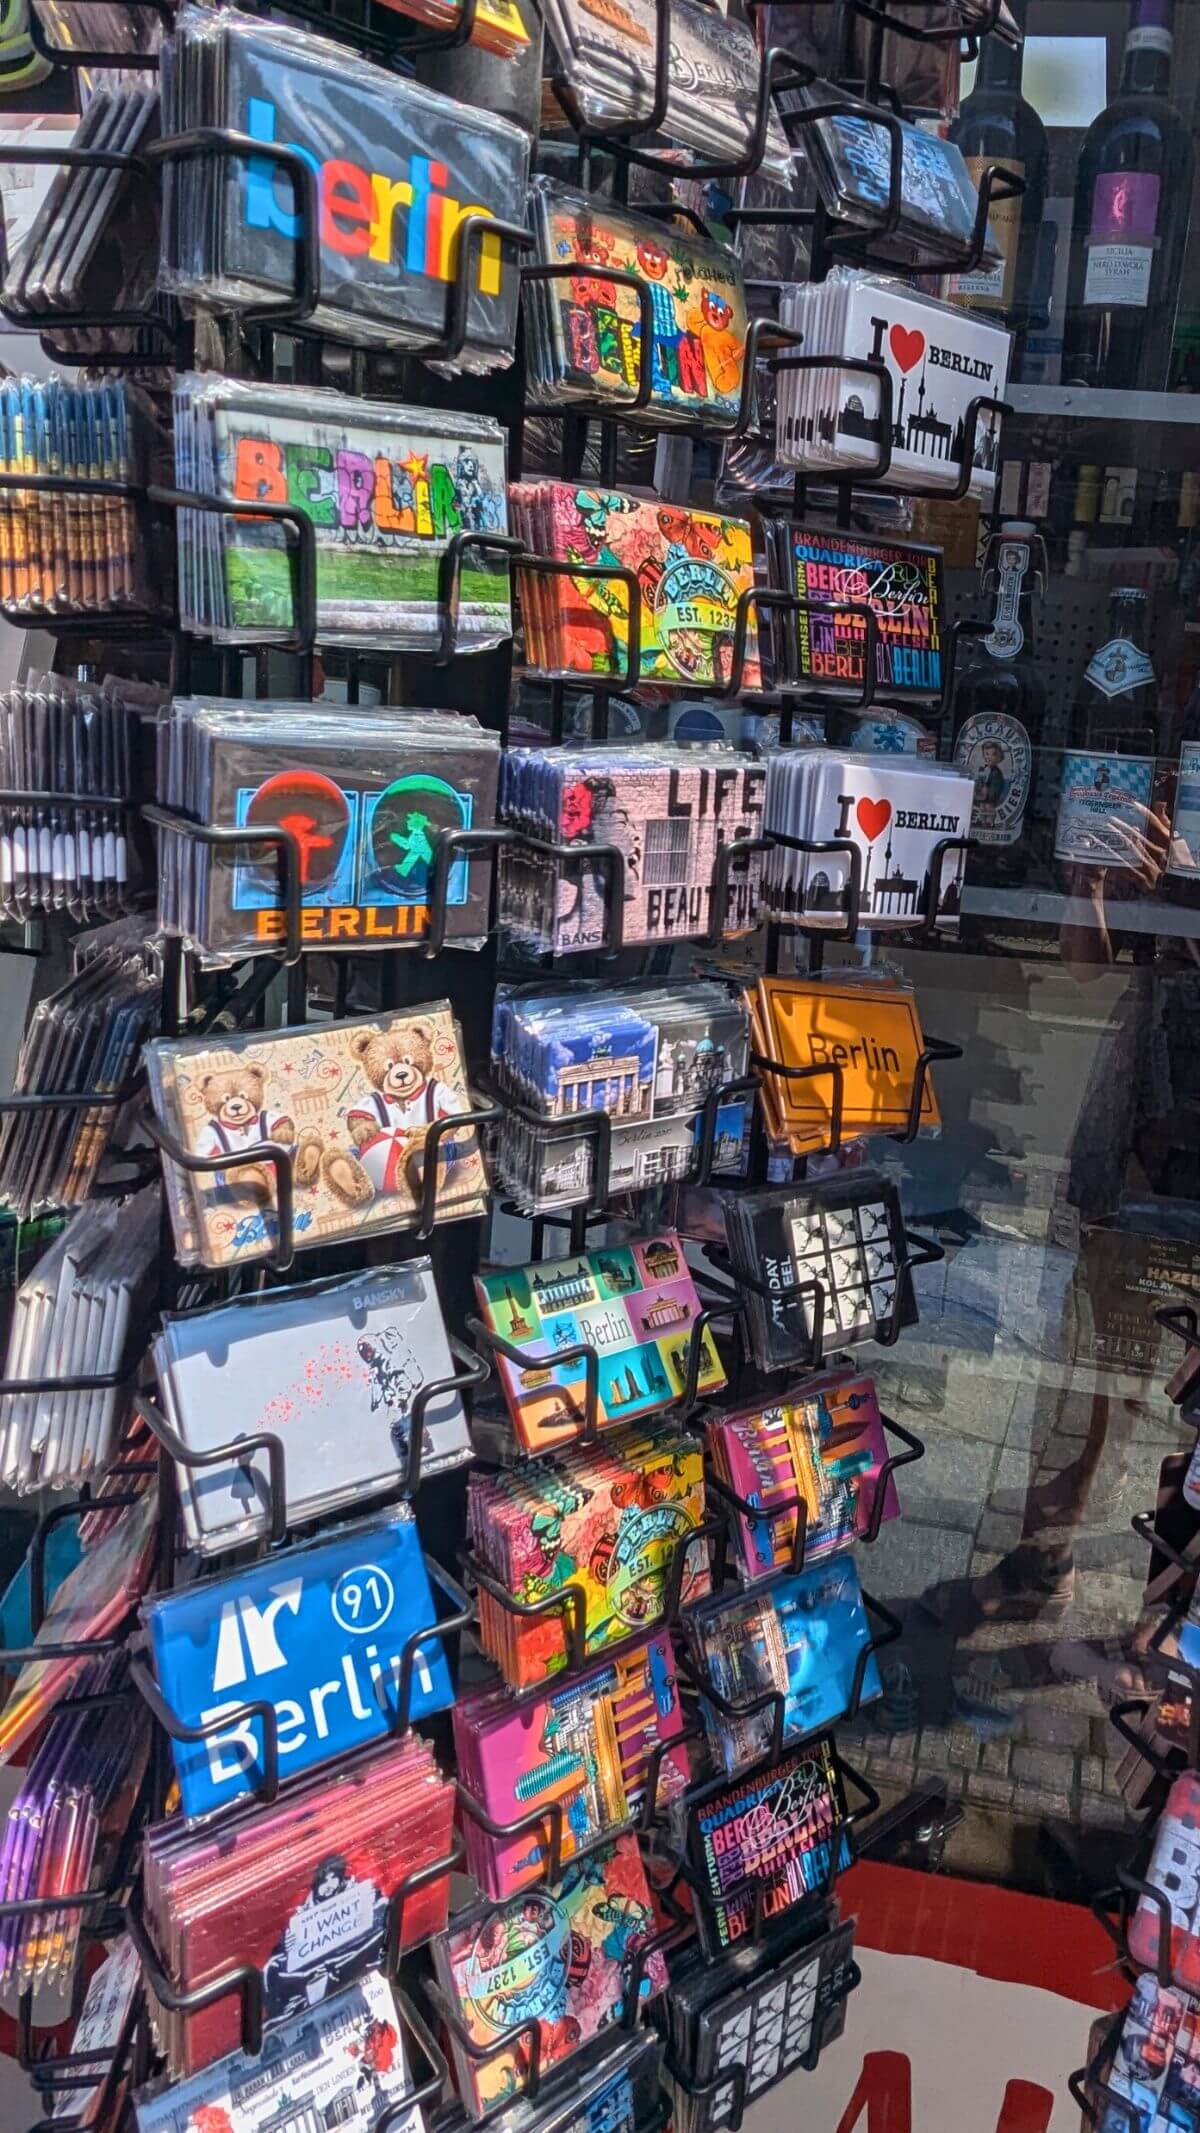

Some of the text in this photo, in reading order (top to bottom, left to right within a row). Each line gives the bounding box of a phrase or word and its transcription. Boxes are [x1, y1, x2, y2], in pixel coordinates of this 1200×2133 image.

[245, 97, 500, 296] berlin
[867, 316, 994, 382] I BERLIN
[233, 437, 463, 541] BERLIN
[796, 545, 885, 571] QUADRIGA
[677, 606, 737, 630] EST. 1237
[796, 560, 811, 674] FERNSETURM
[811, 651, 866, 680] BERLI
[893, 646, 942, 688] BERLIN
[668, 768, 767, 818] LIFE
[998, 787, 1021, 820] BIER
[833, 795, 960, 838] I BERLIN
[648, 884, 758, 926] BEAUTFUL
[807, 1032, 901, 1073] Berlin
[580, 1312, 632, 1347] Berlin
[629, 1554, 653, 1578] EST.
[343, 1576, 382, 1619] 91
[200, 1644, 434, 1785] Berlin
[801, 1832, 852, 1891] BERIN
[703, 1833, 730, 1948] FERNEHTURM
[317, 1900, 361, 1933] WANT
[486, 1965, 517, 1994] 1237
